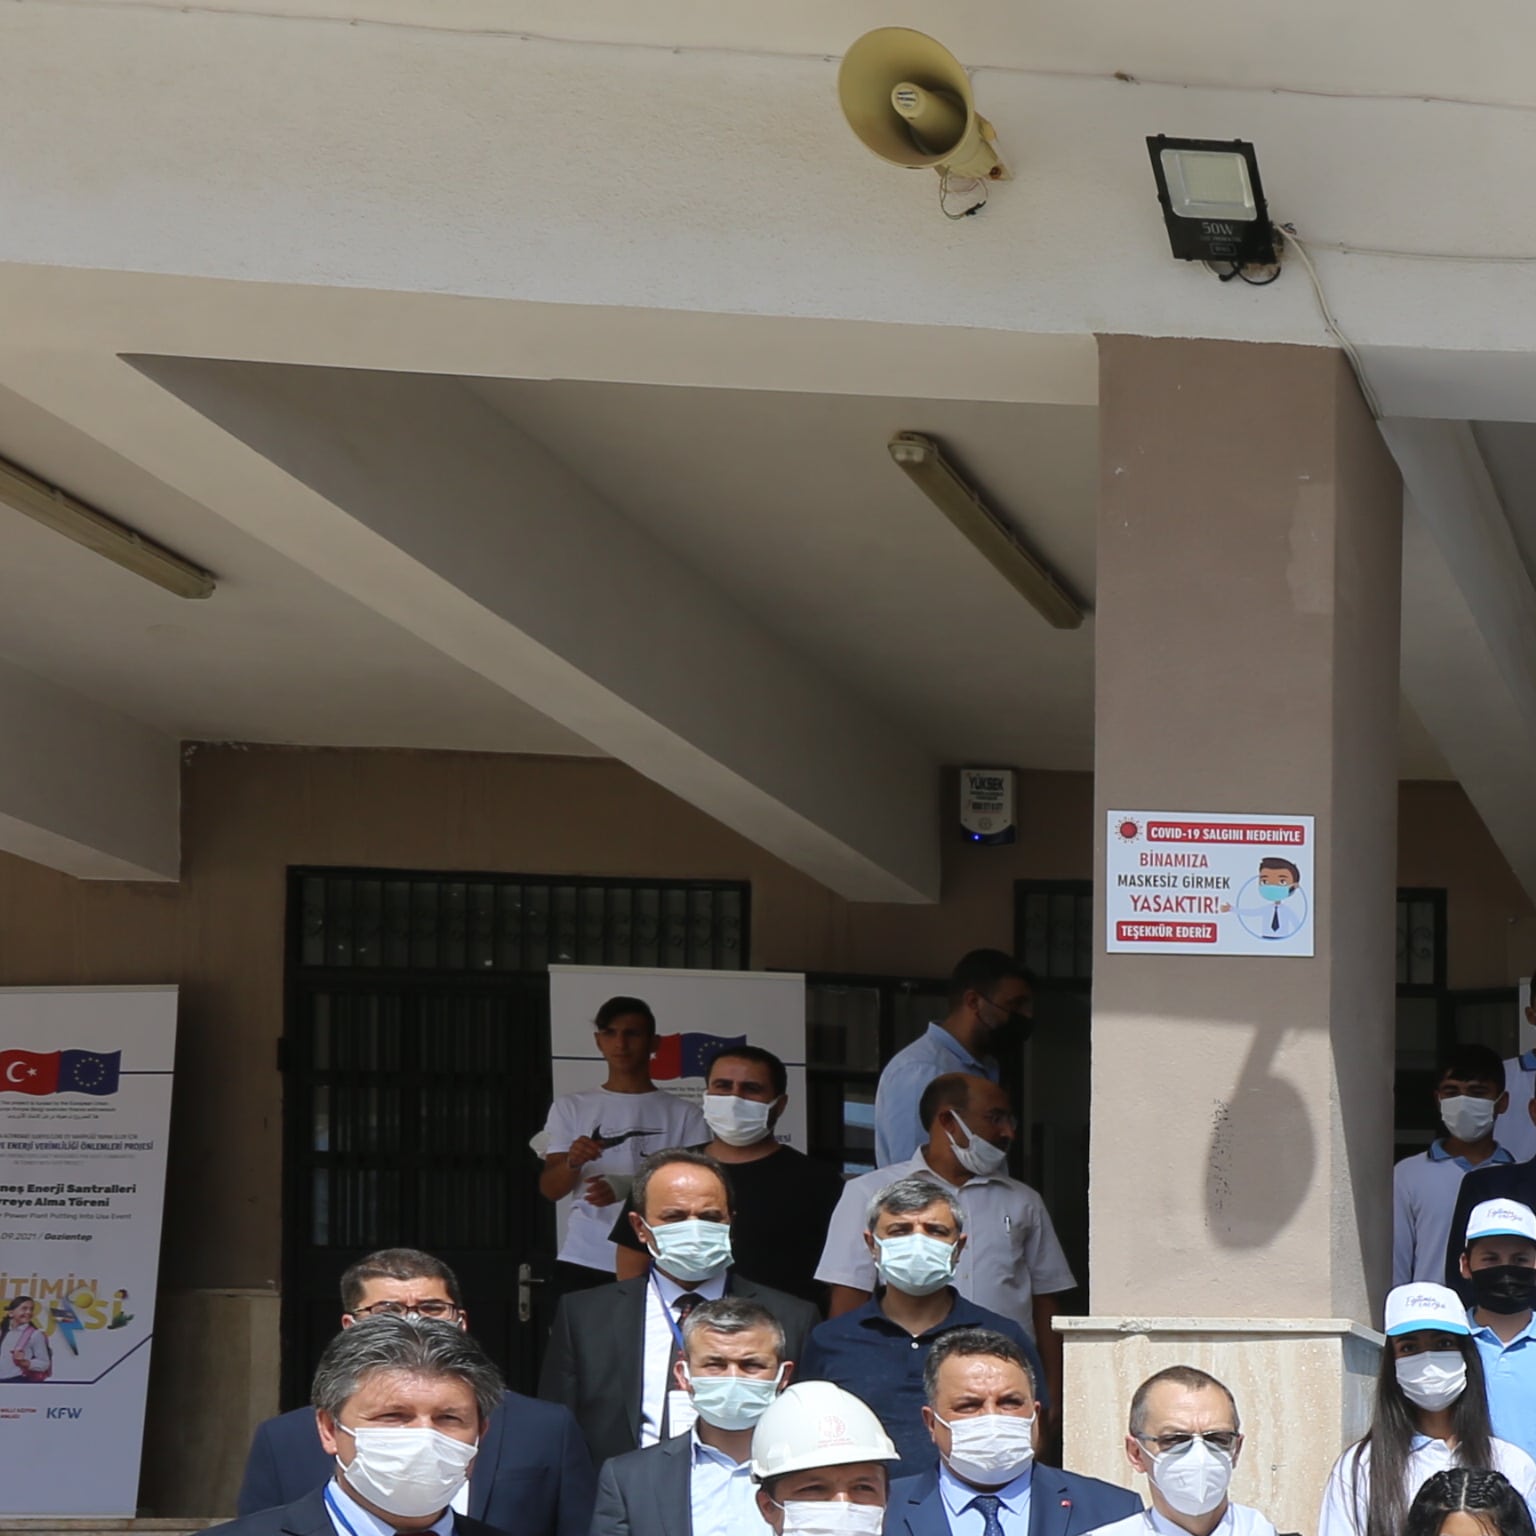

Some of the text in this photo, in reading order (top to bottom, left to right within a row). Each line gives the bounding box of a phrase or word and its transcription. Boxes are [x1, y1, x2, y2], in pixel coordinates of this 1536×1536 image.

[1151, 827, 1300, 842] COVID-19 SALGINI NEDENİYLE
[1140, 850, 1208, 868] BİNAMIZA
[1118, 872, 1230, 889] MASKESİZ GİRMEK
[1130, 895, 1219, 913] YASAKTIR!
[1121, 924, 1212, 940] TEŞEKKÜR EDERİZ
[27, 1183, 65, 1195] Enerji
[67, 1184, 136, 1193] Santralleri
[34, 1198, 66, 1206] Alma
[68, 1197, 110, 1206] Töreni
[44, 1233, 92, 1241] Gaziantep
